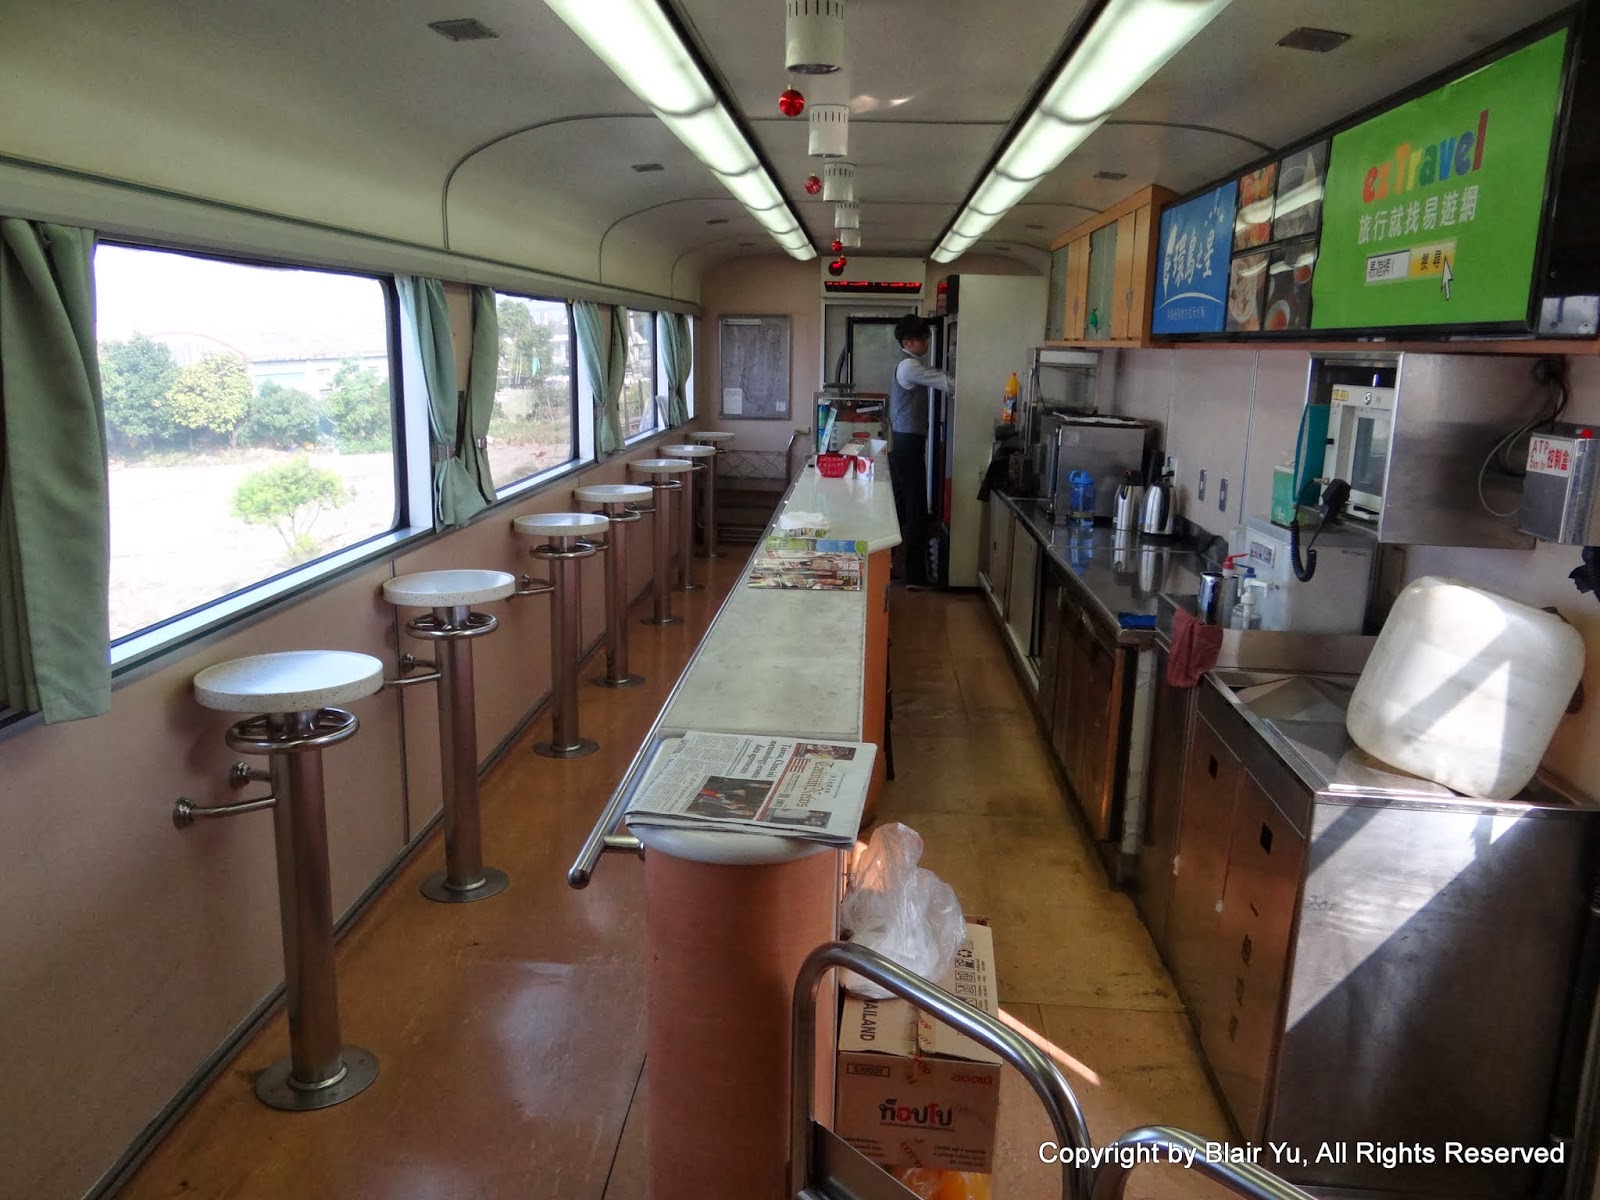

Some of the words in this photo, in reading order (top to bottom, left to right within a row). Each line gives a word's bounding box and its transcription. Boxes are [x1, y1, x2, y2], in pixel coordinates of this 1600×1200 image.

[1357, 185, 1480, 245] 旅行就找易遊網
[1532, 439, 1550, 455] ATP
